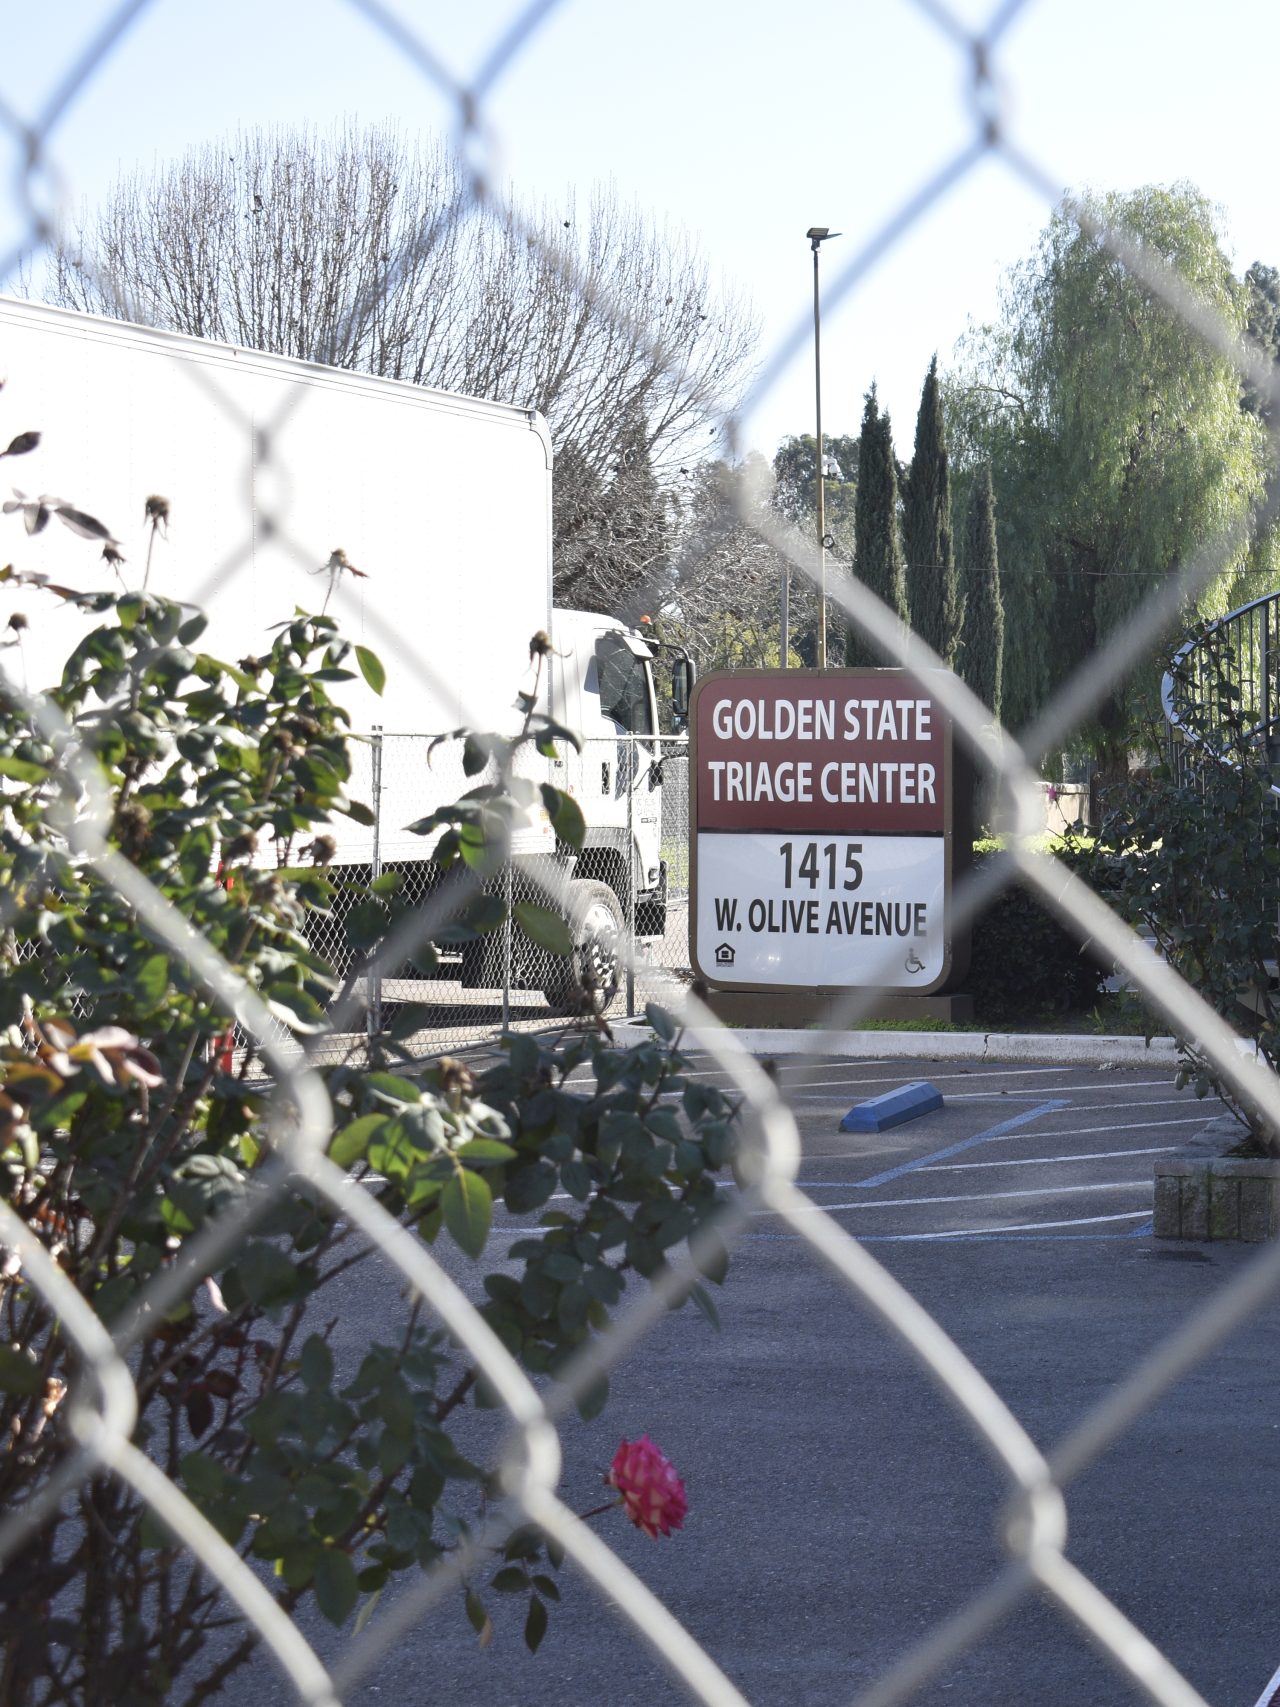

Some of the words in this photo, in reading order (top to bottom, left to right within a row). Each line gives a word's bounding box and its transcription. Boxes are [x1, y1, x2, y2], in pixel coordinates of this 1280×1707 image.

[713, 699, 835, 740] GOLDEN
[844, 699, 931, 741] STATE
[708, 761, 813, 802] TRIAGE
[821, 762, 936, 804] CENTER
[780, 843, 863, 890] 1415
[715, 898, 741, 932] W.
[749, 900, 819, 934] OLIVE
[826, 902, 927, 936] AVENUE
